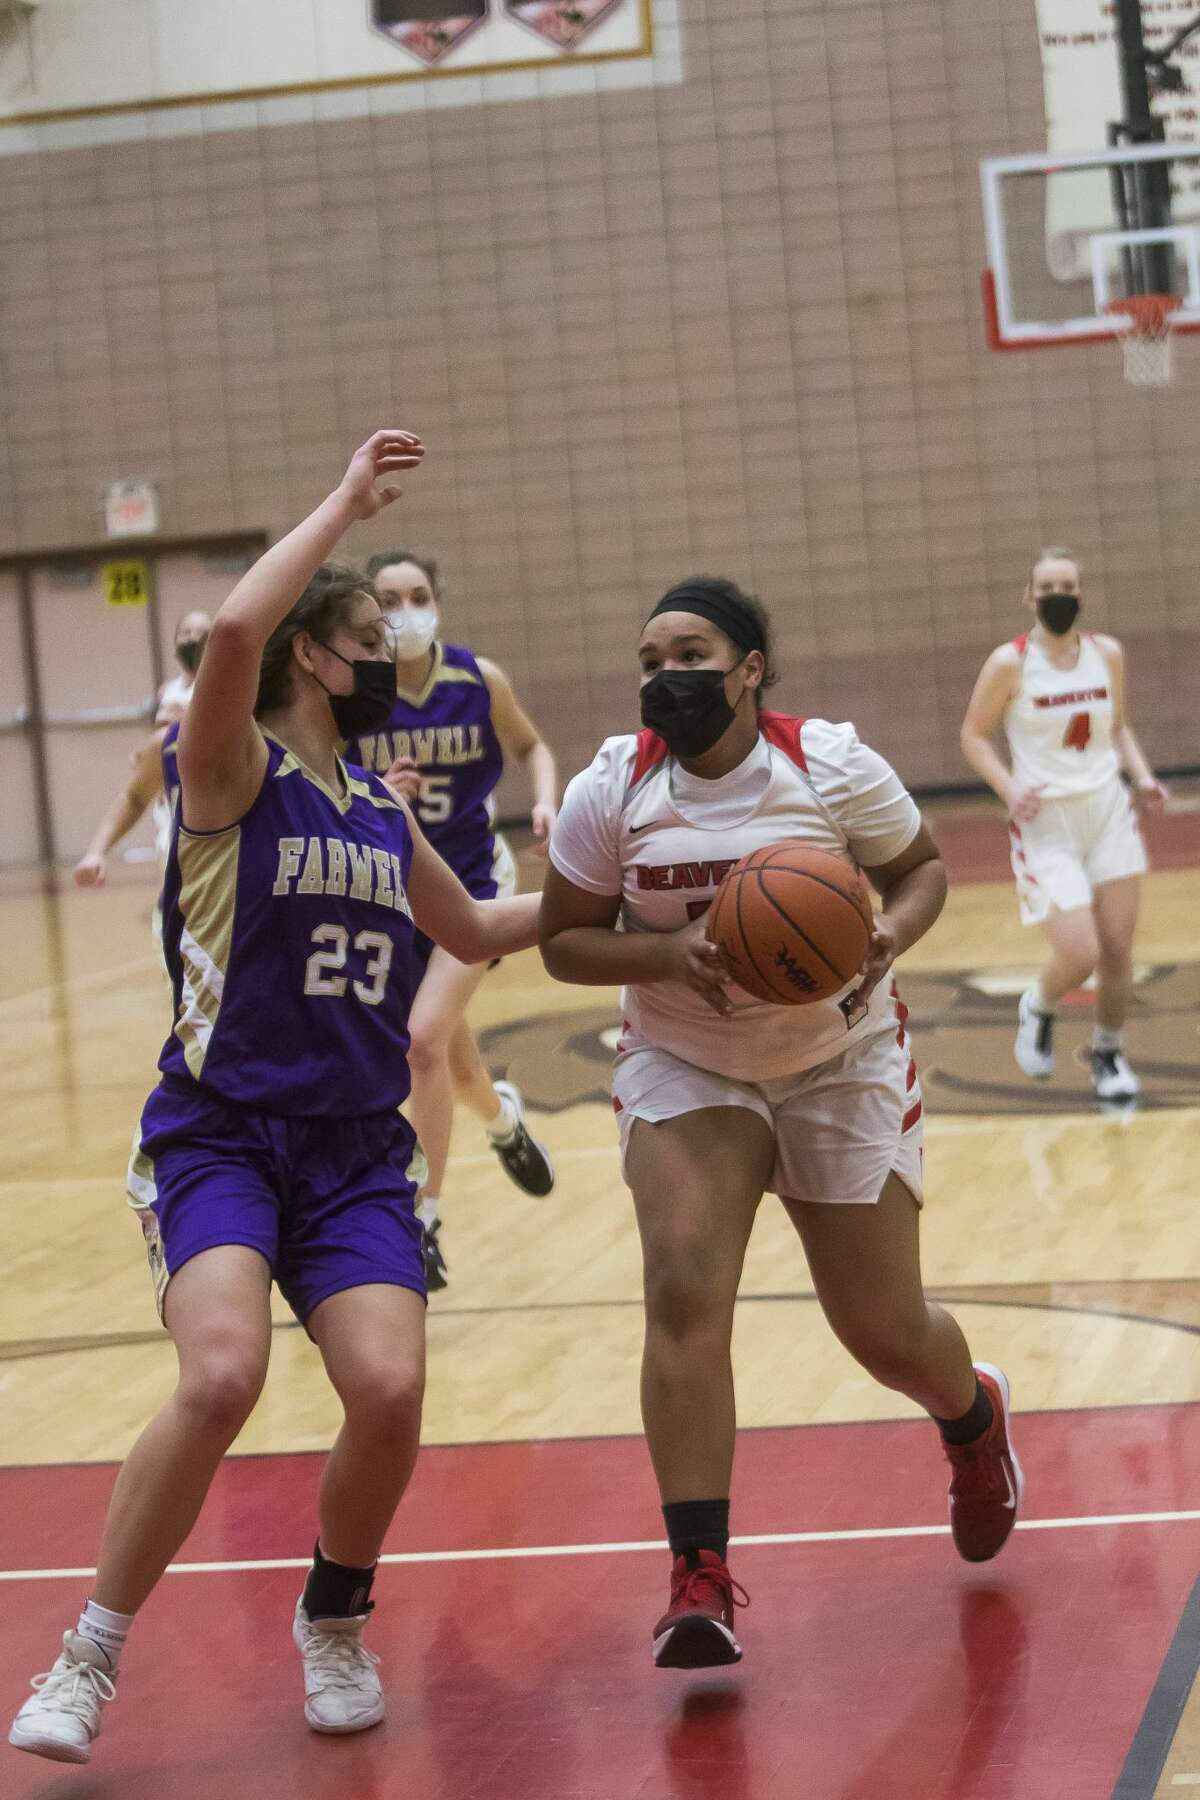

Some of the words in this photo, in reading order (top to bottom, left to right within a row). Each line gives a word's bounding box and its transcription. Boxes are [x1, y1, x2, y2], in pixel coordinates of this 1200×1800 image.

[358, 725, 485, 772] FARWELL
[1063, 711, 1090, 752] 4
[303, 922, 394, 1006] 23
